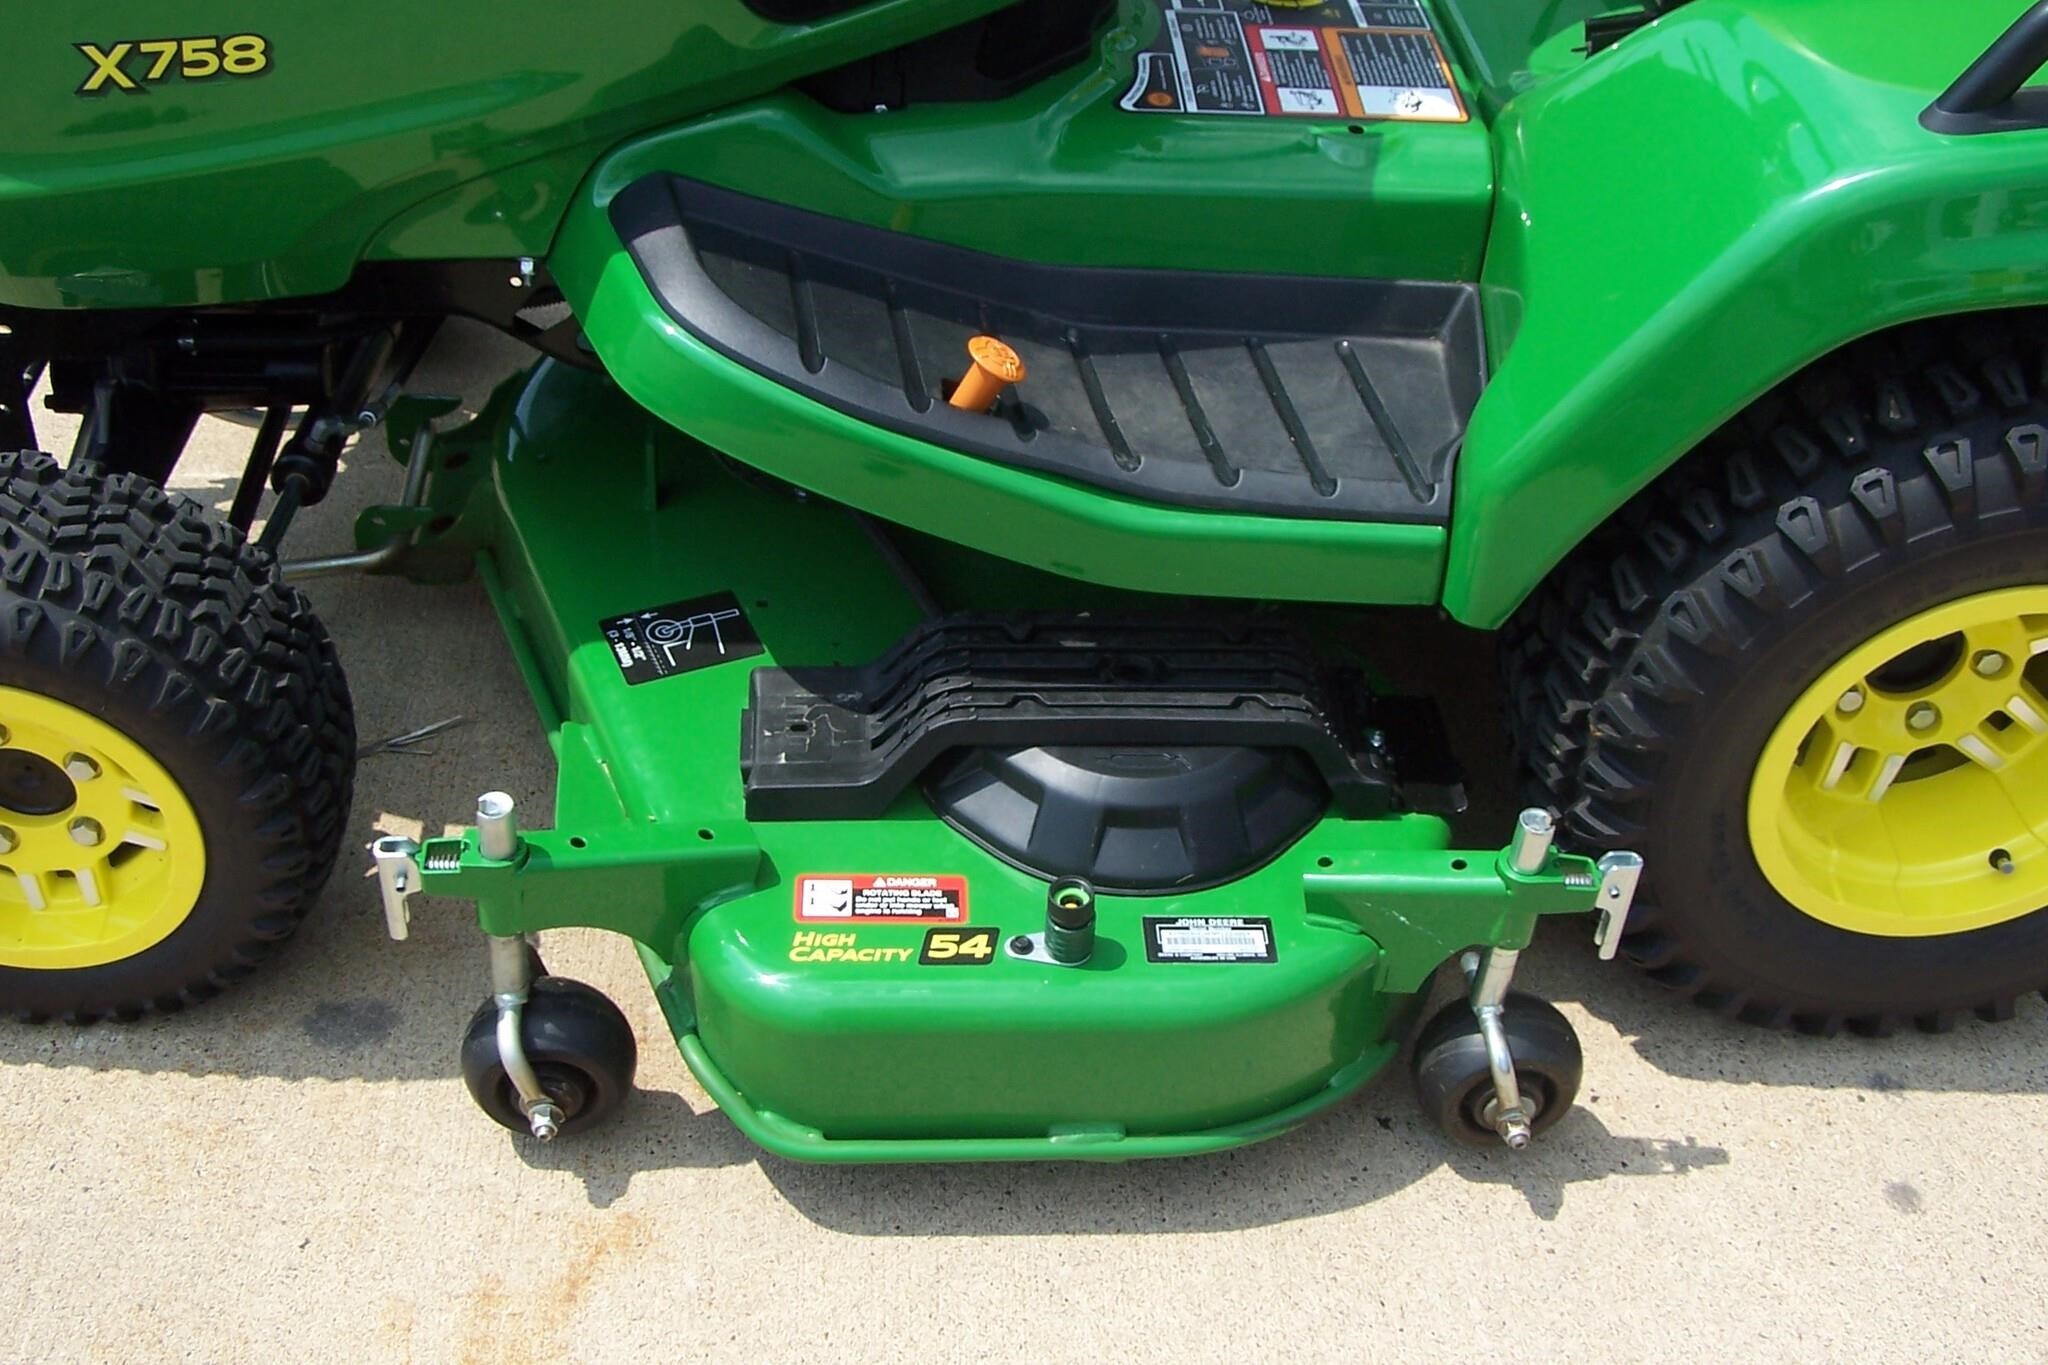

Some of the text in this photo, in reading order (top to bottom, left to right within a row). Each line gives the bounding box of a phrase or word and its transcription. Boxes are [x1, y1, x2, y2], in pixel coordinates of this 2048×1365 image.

[78, 34, 268, 92] X758
[886, 877, 937, 888] DANGER
[862, 889, 943, 897] ROTATING BLADE
[1176, 918, 1244, 926] JOHN DEERE
[792, 931, 857, 947] HIGH
[927, 933, 993, 960] 54
[788, 947, 914, 963] CAPACITY
